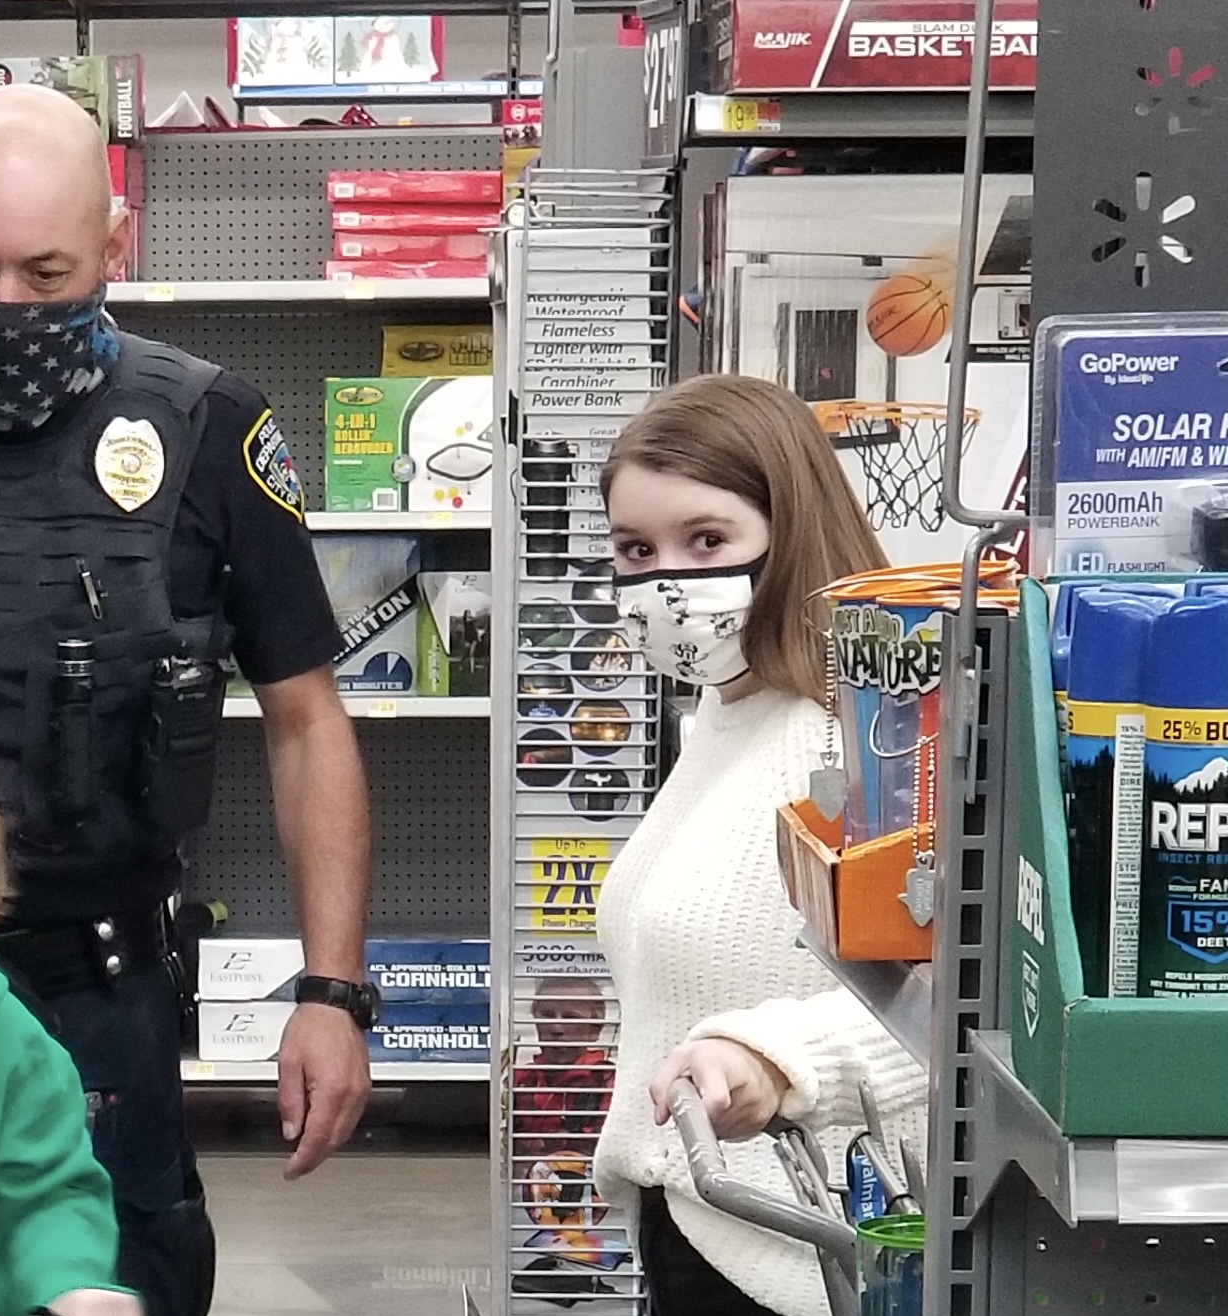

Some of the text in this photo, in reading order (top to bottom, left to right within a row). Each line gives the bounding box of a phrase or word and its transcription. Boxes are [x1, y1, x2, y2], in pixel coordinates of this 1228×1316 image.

[913, 23, 1004, 33] SLAM DK
[117, 79, 133, 138] FOOTBALL
[541, 322, 616, 338] Flameless
[533, 343, 623, 358] Lighter with
[1079, 352, 1180, 374] GoPower
[531, 391, 624, 407] Power Bank
[1112, 412, 1213, 442] SOLAR
[1095, 448, 1125, 464] WITH
[1127, 445, 1187, 468] AM/FM
[1191, 446, 1204, 467] &
[265, 474, 288, 499] CITY
[1067, 491, 1164, 515] 2600mAh
[1067, 516, 1161, 530] POWERBANK
[1066, 551, 1166, 574] LED FLASHLIGHT
[1162, 719, 1202, 740] 25%
[390, 964, 442, 973] APPROVED
[392, 1025, 444, 1034] APPROVED
